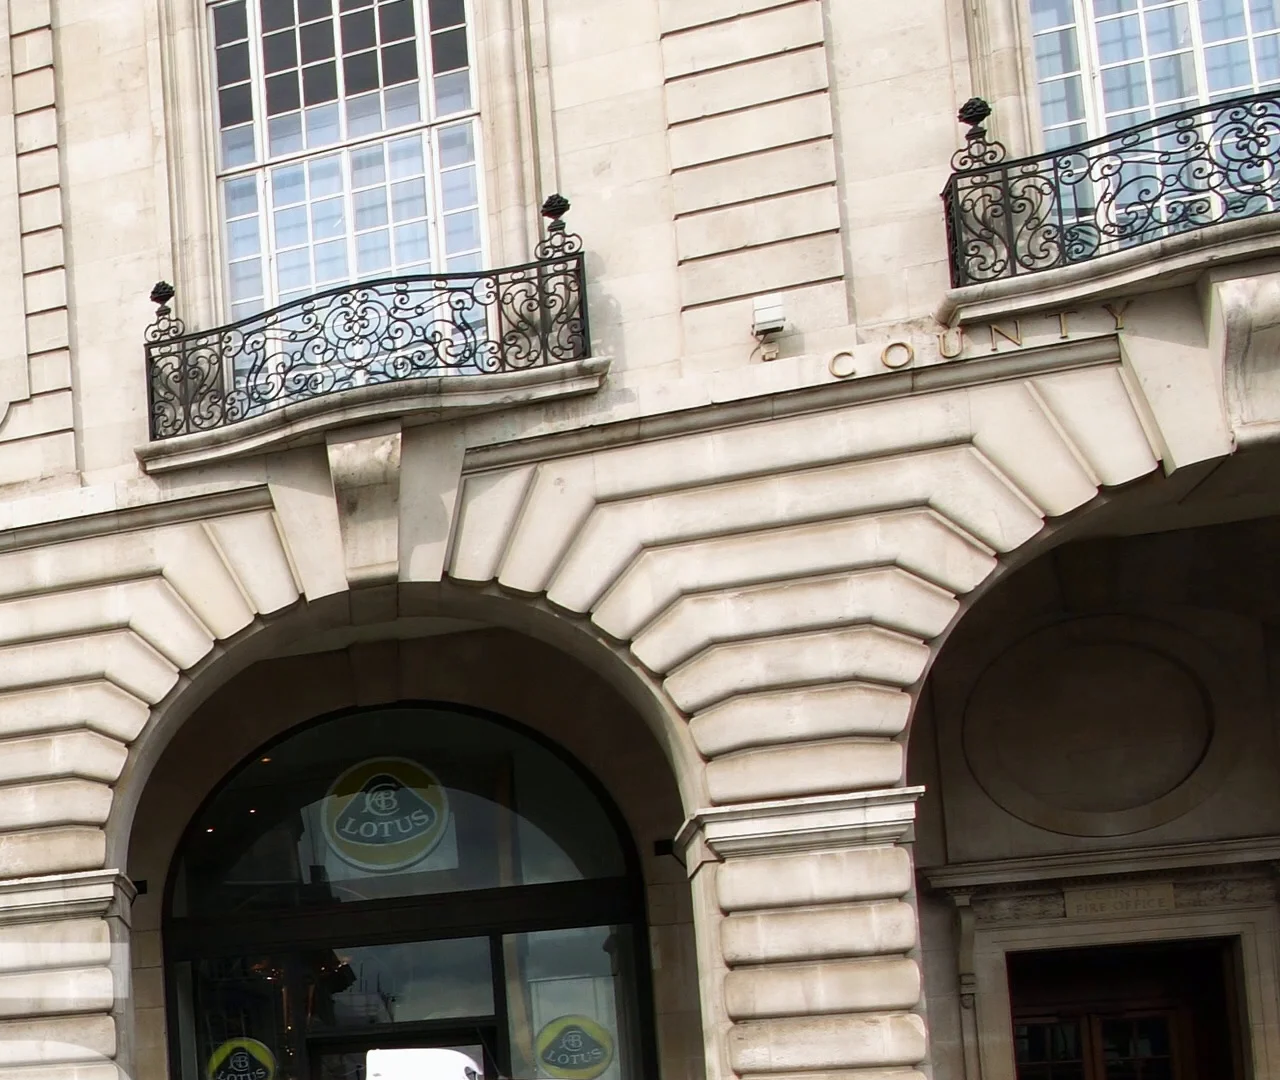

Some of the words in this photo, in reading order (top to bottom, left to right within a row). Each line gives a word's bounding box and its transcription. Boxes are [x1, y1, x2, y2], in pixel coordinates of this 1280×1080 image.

[828, 301, 1131, 378] COUNTY
[341, 808, 430, 838] LOTUS
[544, 1048, 602, 1065] LOTUS
